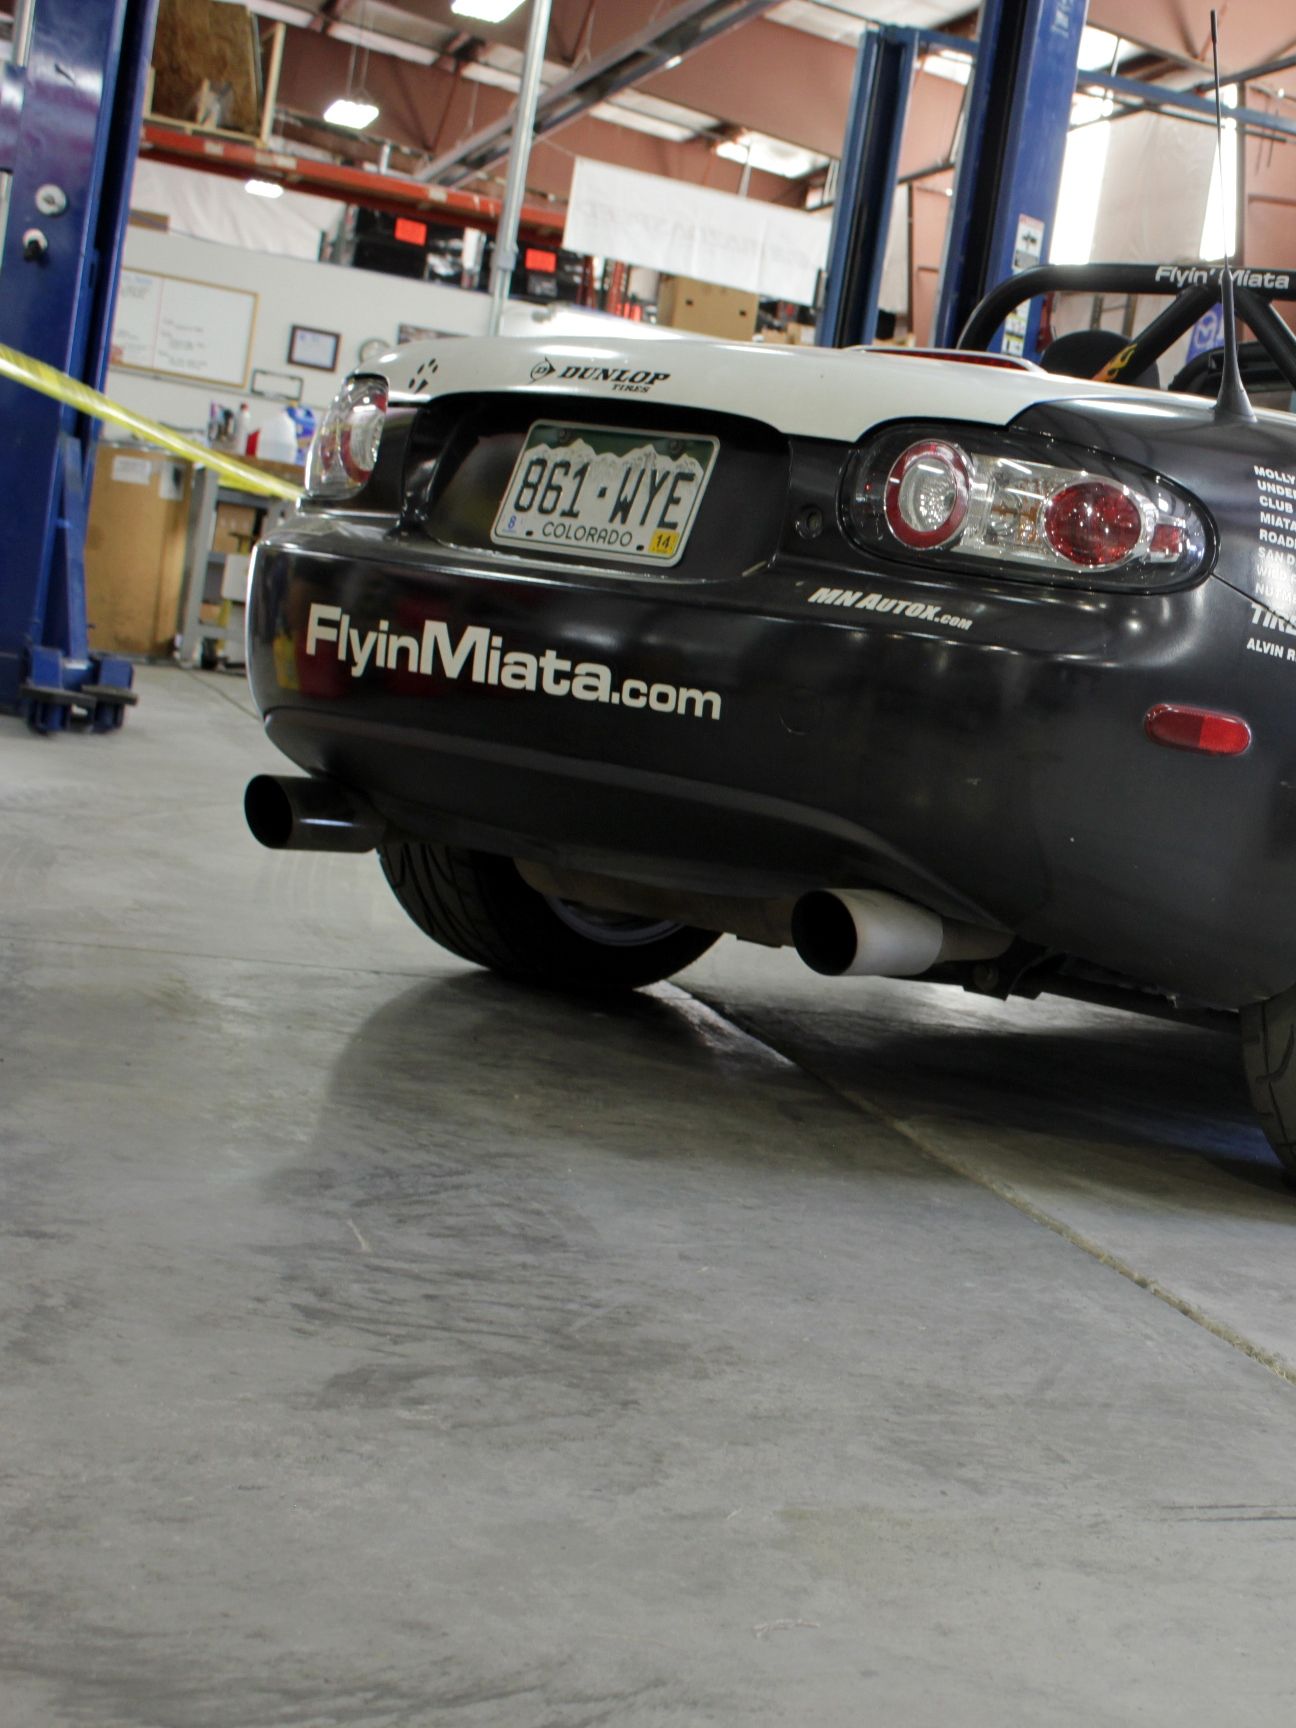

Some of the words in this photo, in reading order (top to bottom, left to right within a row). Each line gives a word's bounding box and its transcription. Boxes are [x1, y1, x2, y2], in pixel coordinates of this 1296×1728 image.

[1155, 265, 1215, 288] Flyin'
[1218, 269, 1290, 290] Miata
[558, 366, 671, 385] DUNLOP
[612, 383, 651, 393] TIRES
[1254, 465, 1296, 485] MOLLY
[1259, 495, 1294, 514] CLUB
[541, 521, 633, 547] COLORADO
[655, 534, 671, 549] 14
[1258, 547, 1284, 564] SAN
[807, 587, 863, 607] MN
[1246, 637, 1285, 659] ALVIN
[305, 602, 722, 721] FlyinMiata.com
